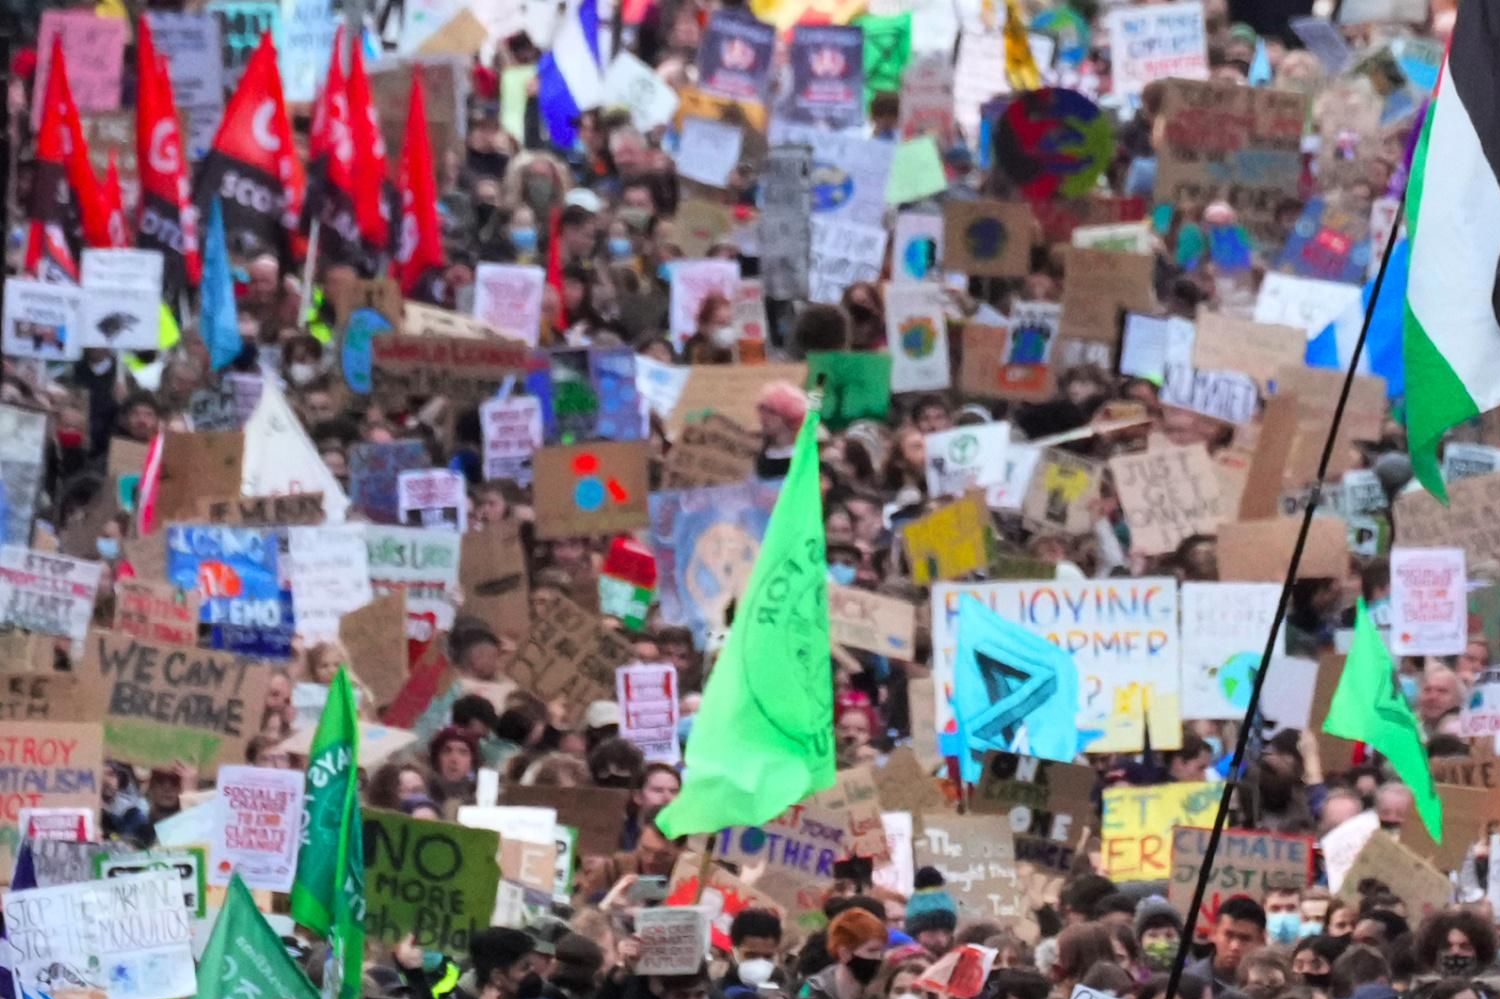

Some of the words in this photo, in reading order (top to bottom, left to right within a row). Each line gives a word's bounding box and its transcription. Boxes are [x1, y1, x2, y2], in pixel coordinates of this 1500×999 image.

[100, 639, 161, 686] WE
[362, 820, 464, 884] NO
[374, 872, 466, 918] MORE
